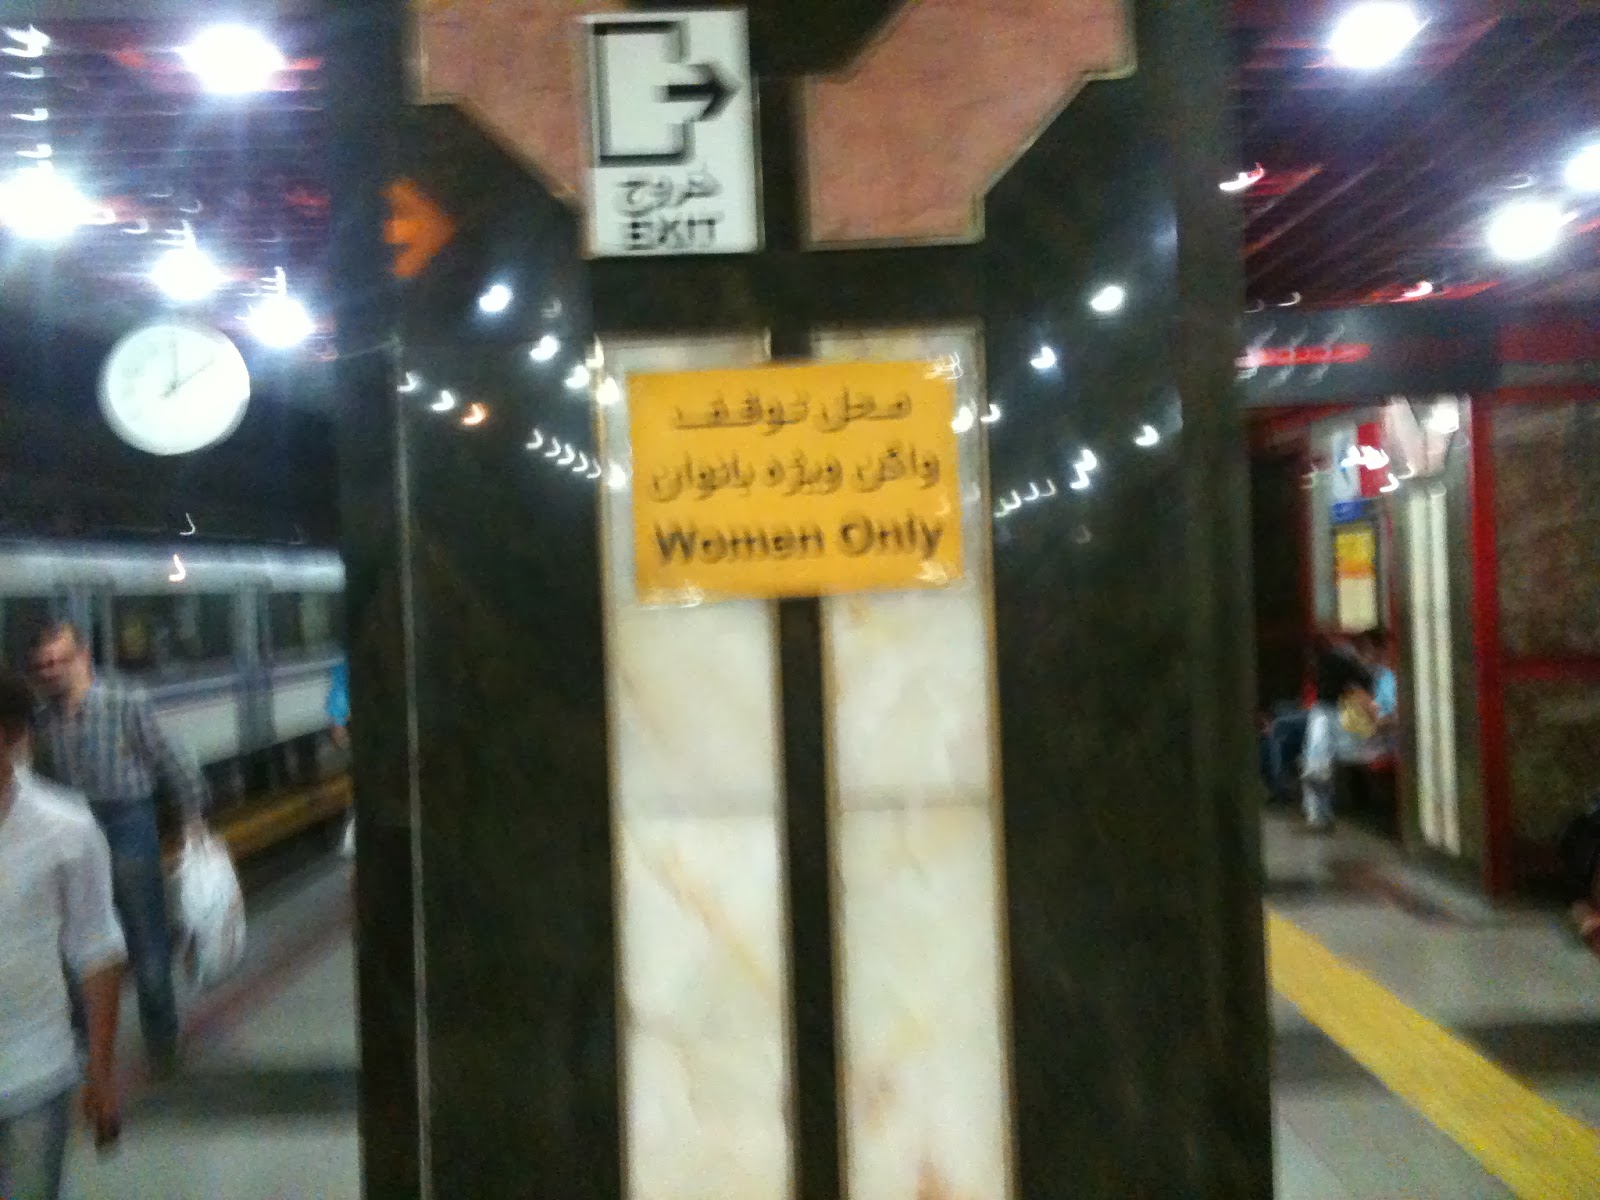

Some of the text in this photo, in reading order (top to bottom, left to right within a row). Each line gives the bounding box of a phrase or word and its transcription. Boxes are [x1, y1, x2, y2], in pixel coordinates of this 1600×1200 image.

[615, 166, 721, 218] خروج
[617, 212, 723, 251] EXIT
[672, 386, 912, 436] محل توقف
[649, 450, 756, 504] بانوان
[653, 509, 944, 565] Women Only
